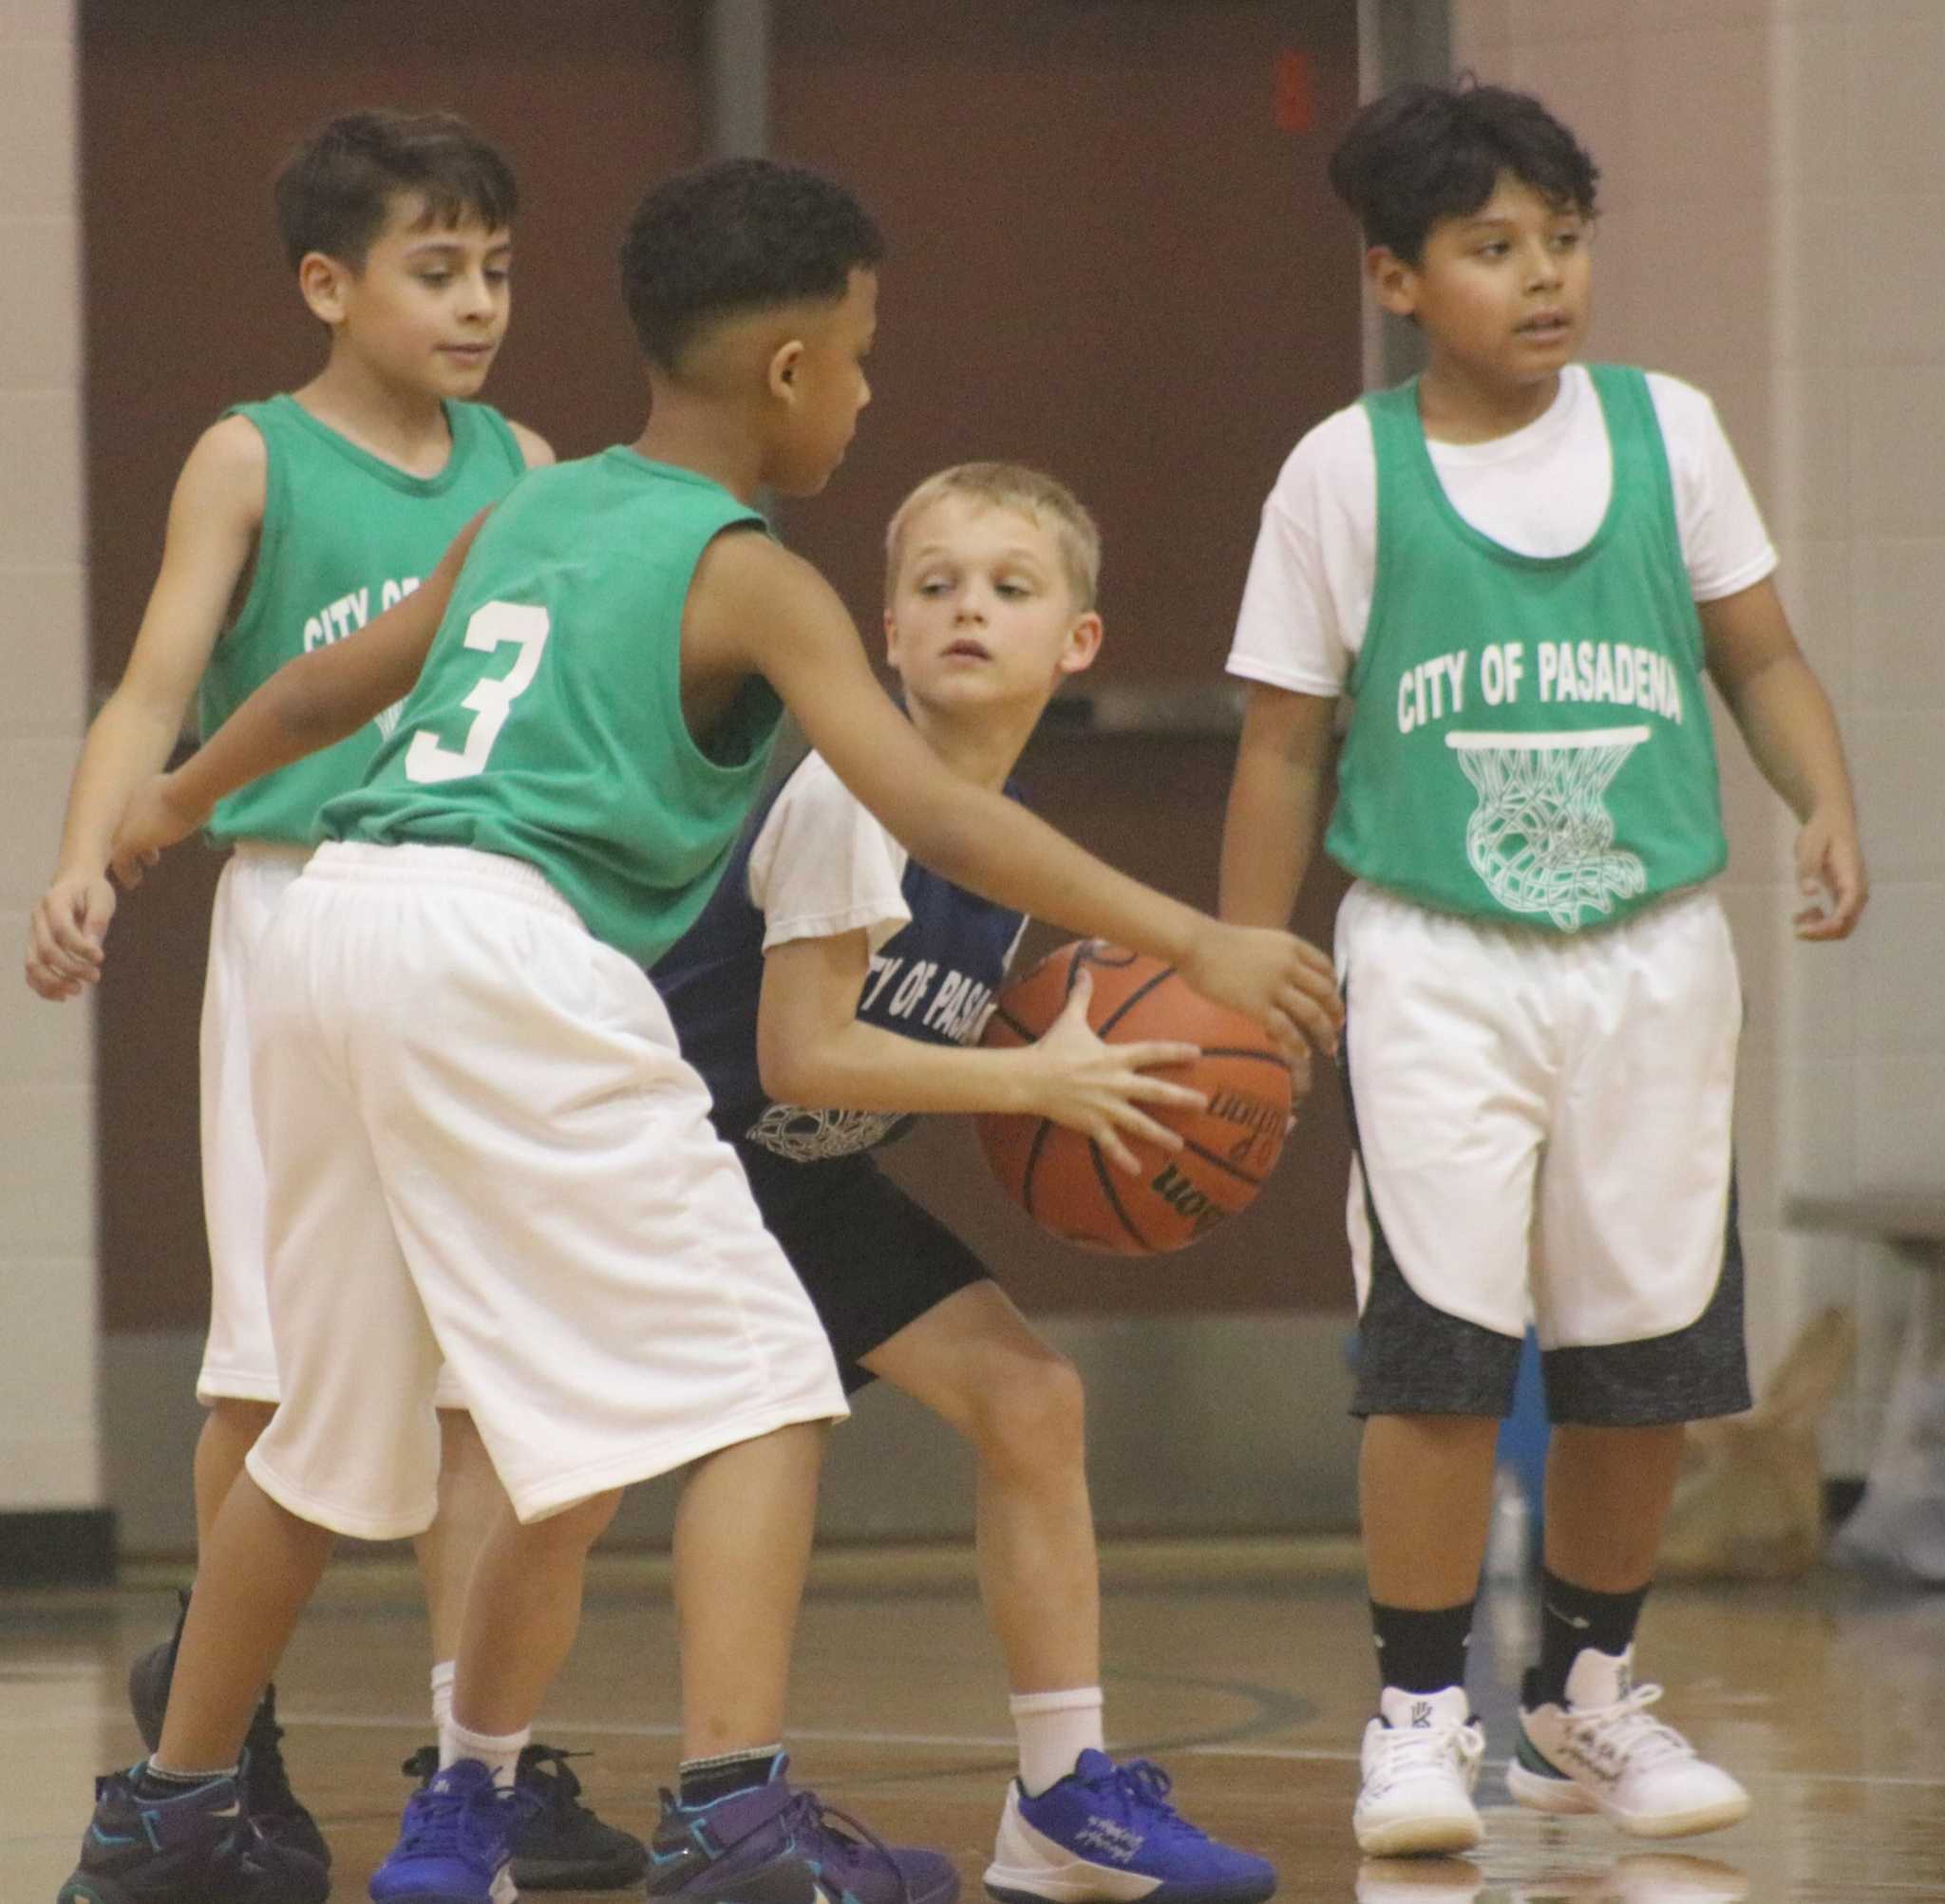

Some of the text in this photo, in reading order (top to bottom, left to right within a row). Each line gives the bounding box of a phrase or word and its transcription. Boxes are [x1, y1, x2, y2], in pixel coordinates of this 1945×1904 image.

[405, 599, 550, 783] 3
[1398, 640, 1683, 734] CITY OF PASADENA
[888, 960, 938, 1019] OF
